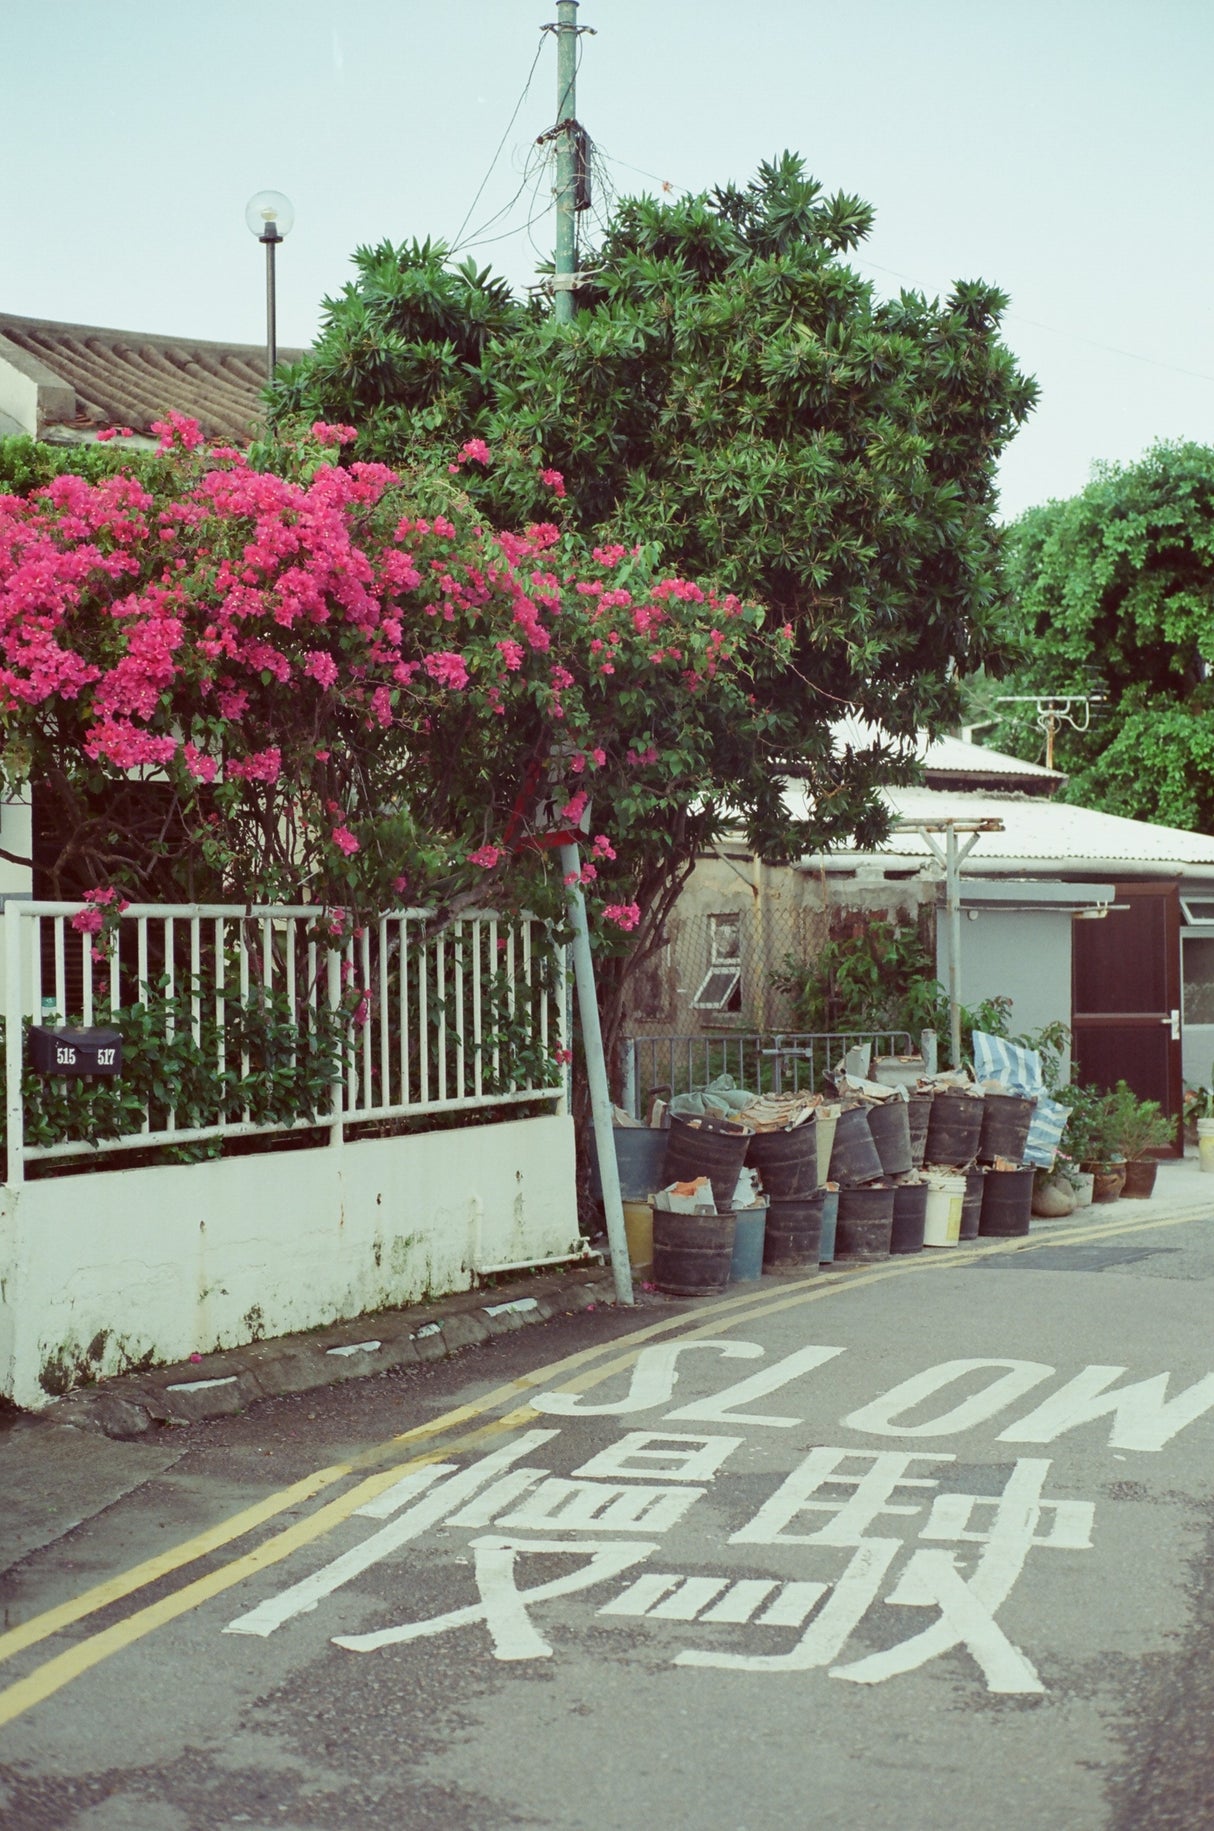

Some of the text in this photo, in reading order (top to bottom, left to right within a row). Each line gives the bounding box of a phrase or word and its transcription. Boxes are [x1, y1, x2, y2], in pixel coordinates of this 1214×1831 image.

[57, 1048, 115, 1065] 515 517
[529, 1340, 1214, 1452] SLOW
[222, 1428, 1095, 1694] 慢駛
